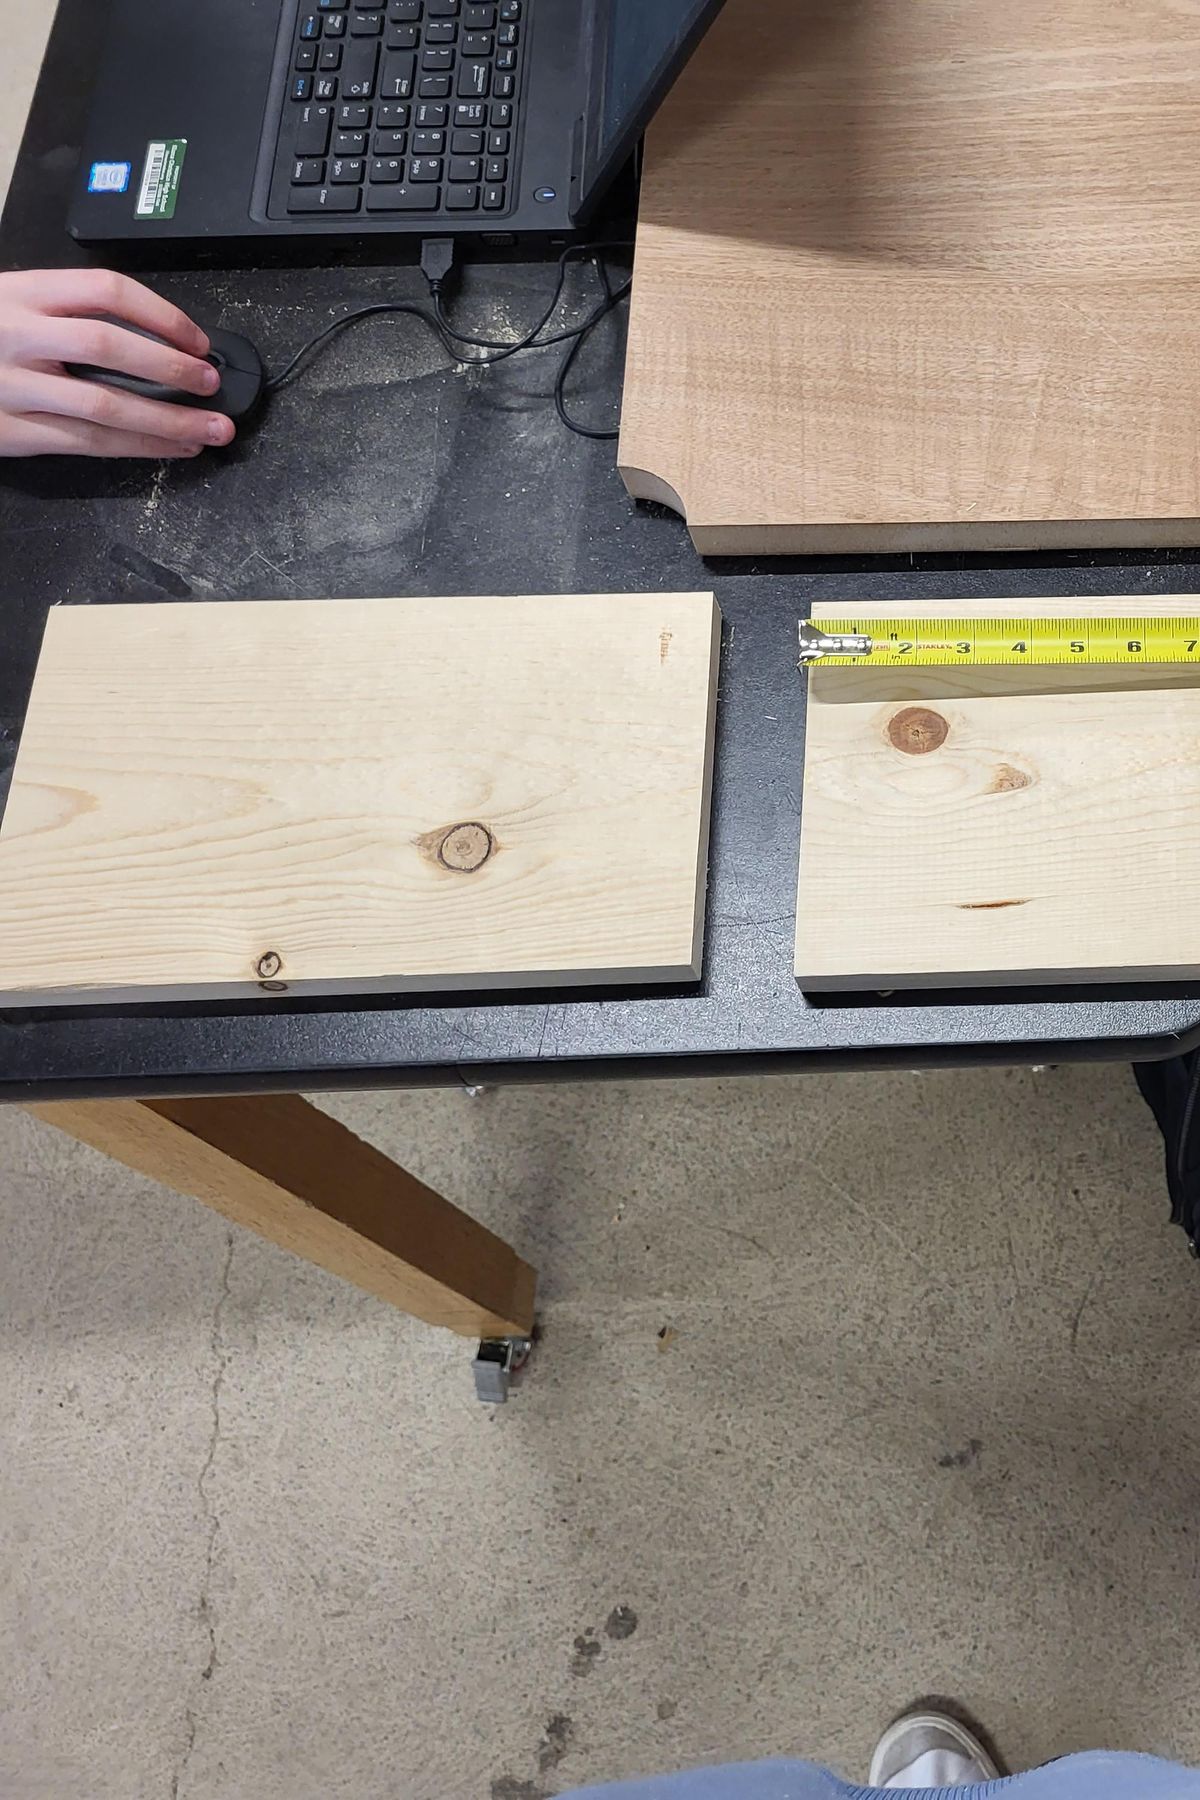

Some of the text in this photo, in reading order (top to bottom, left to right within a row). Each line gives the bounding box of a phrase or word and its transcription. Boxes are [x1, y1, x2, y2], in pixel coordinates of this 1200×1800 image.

[342, 107, 350, 117] End
[419, 105, 427, 120] Home
[334, 161, 342, 176] PgDn
[890, 633, 898, 641] ft
[898, 642, 913, 655] 2
[956, 642, 971, 654] 3
[1011, 641, 1028, 653] 4
[1070, 641, 1085, 653] 5
[1127, 641, 1142, 652] 6
[1183, 640, 1198, 652] 7
